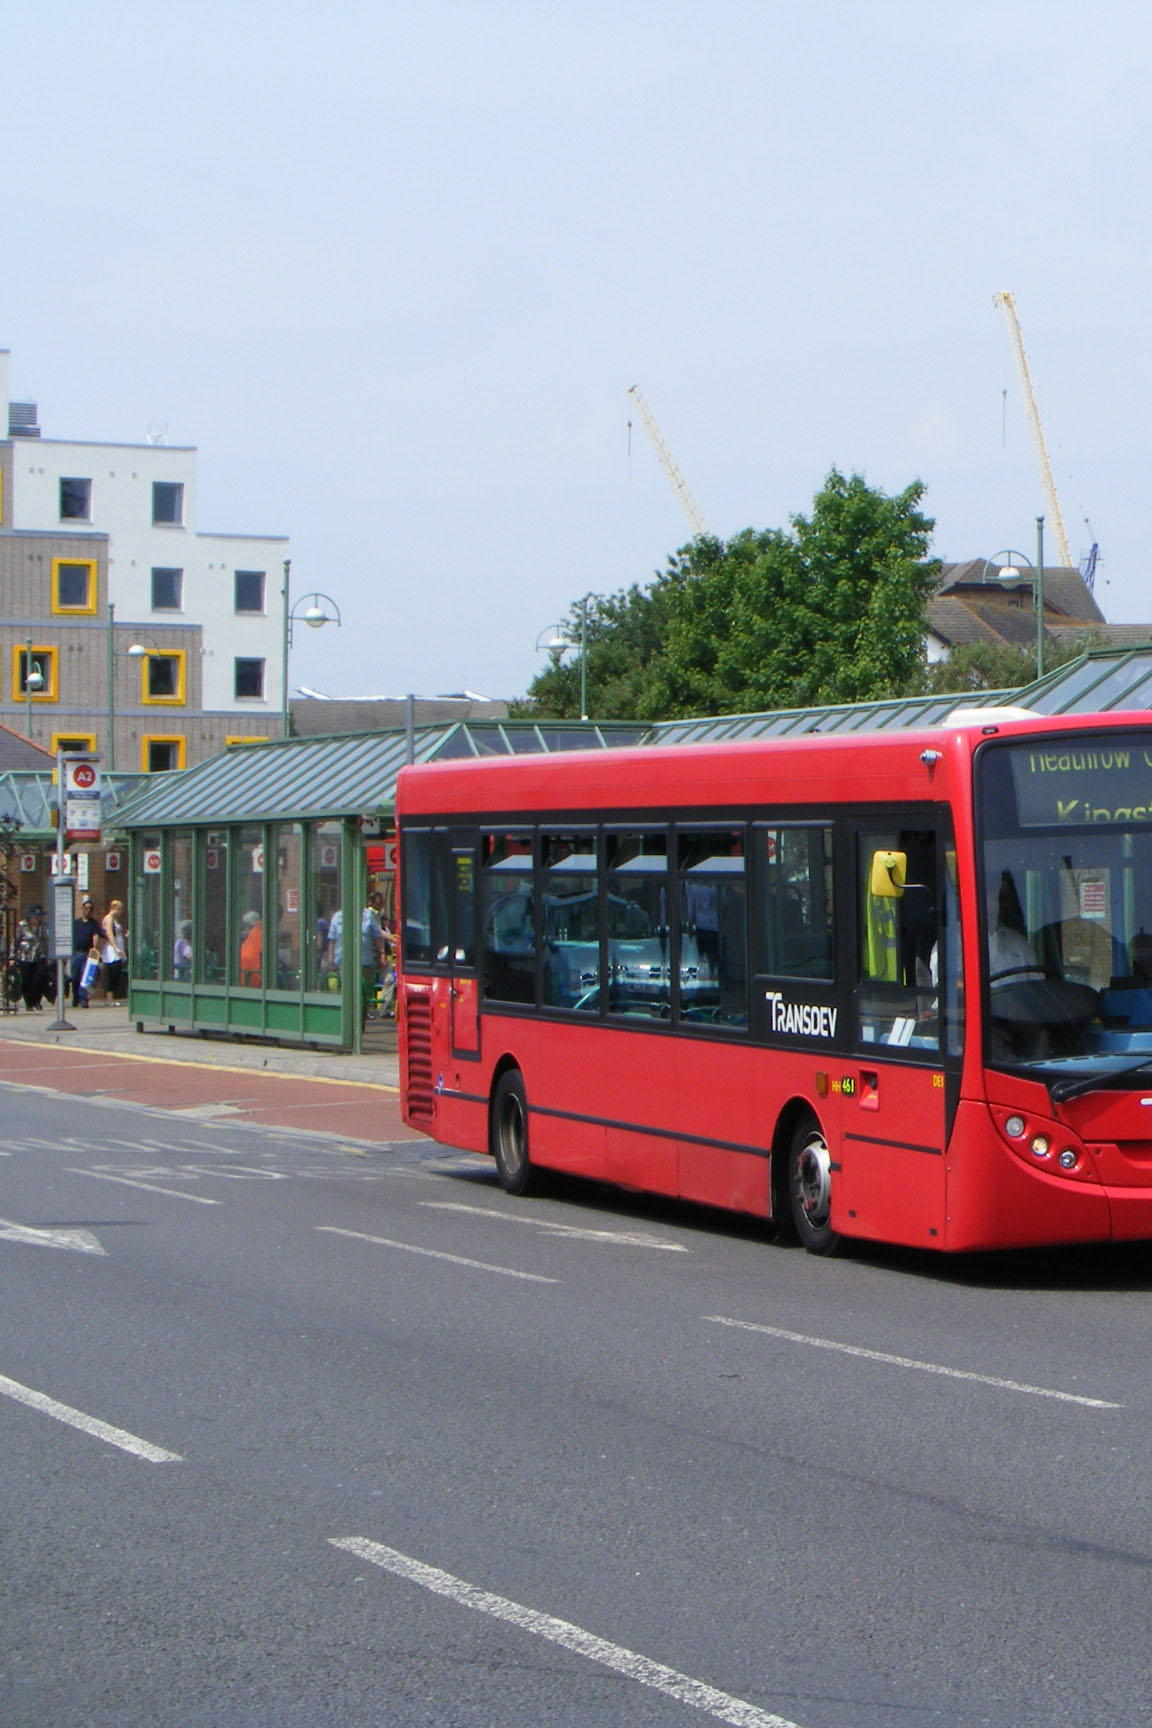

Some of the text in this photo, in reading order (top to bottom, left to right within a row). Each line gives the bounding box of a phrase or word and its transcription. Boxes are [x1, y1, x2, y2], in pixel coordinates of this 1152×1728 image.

[77, 771, 93, 783] A2
[765, 991, 838, 1038] TRANSDEV
[842, 1077, 855, 1094] 461
